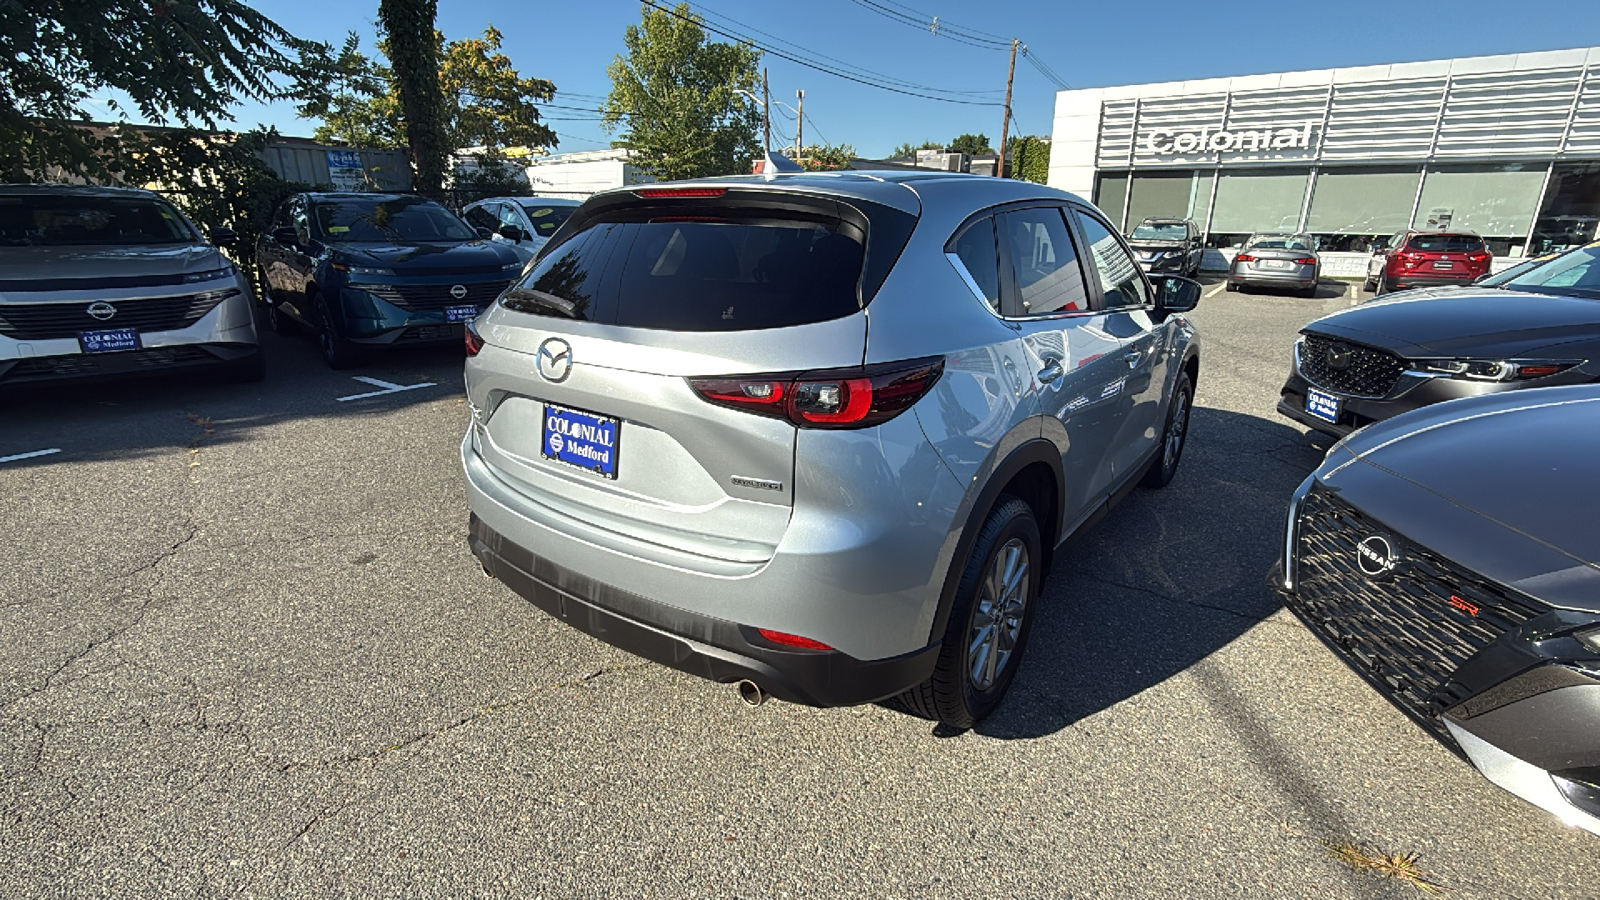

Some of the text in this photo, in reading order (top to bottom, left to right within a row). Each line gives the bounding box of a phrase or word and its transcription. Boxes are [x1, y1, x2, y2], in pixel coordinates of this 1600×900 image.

[1146, 120, 1313, 151] Colonial
[547, 416, 613, 447] COLONIAL
[567, 439, 609, 464] Medford
[1356, 541, 1396, 571] NISSAN
[1448, 594, 1479, 617] SR
